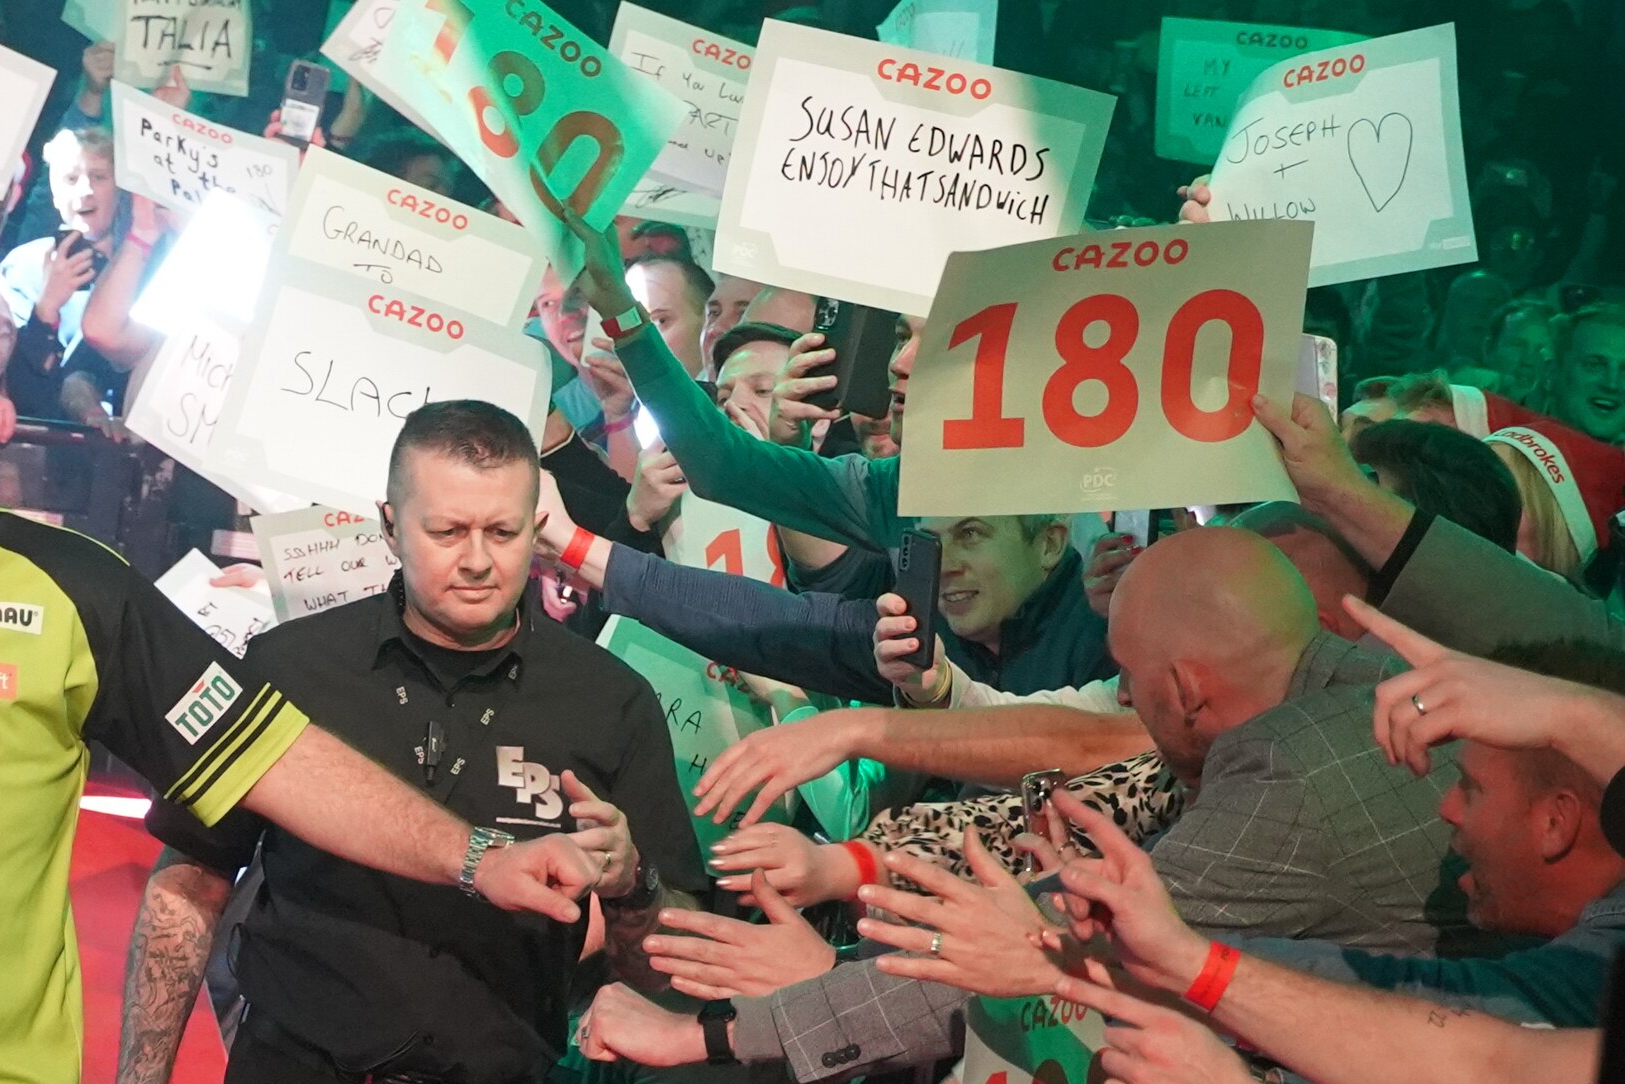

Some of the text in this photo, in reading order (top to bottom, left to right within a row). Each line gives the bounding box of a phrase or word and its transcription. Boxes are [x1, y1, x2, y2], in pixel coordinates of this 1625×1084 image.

[131, 15, 232, 60] TALIA
[505, 0, 602, 78] CAZOO
[692, 39, 751, 70] CAZO
[1236, 31, 1309, 49] CAZOO
[877, 58, 993, 100] CAZOO
[1283, 54, 1366, 88] CAZOO
[171, 113, 234, 145] CAZOO
[1226, 113, 1343, 165] JOSEPH
[154, 152, 176, 175] at
[907, 123, 1051, 182] EDWARDS
[387, 188, 468, 231] CAZOO
[322, 204, 444, 274] GRANDAD
[1052, 238, 1190, 273] CAZOO
[367, 293, 465, 340] CAZOO
[280, 350, 434, 420] SLAC
[942, 288, 1265, 450] 180
[283, 566, 326, 586] TELL
[303, 590, 350, 612] WHAT
[175, 675, 236, 738] TOTO
[495, 745, 564, 820] EPS
